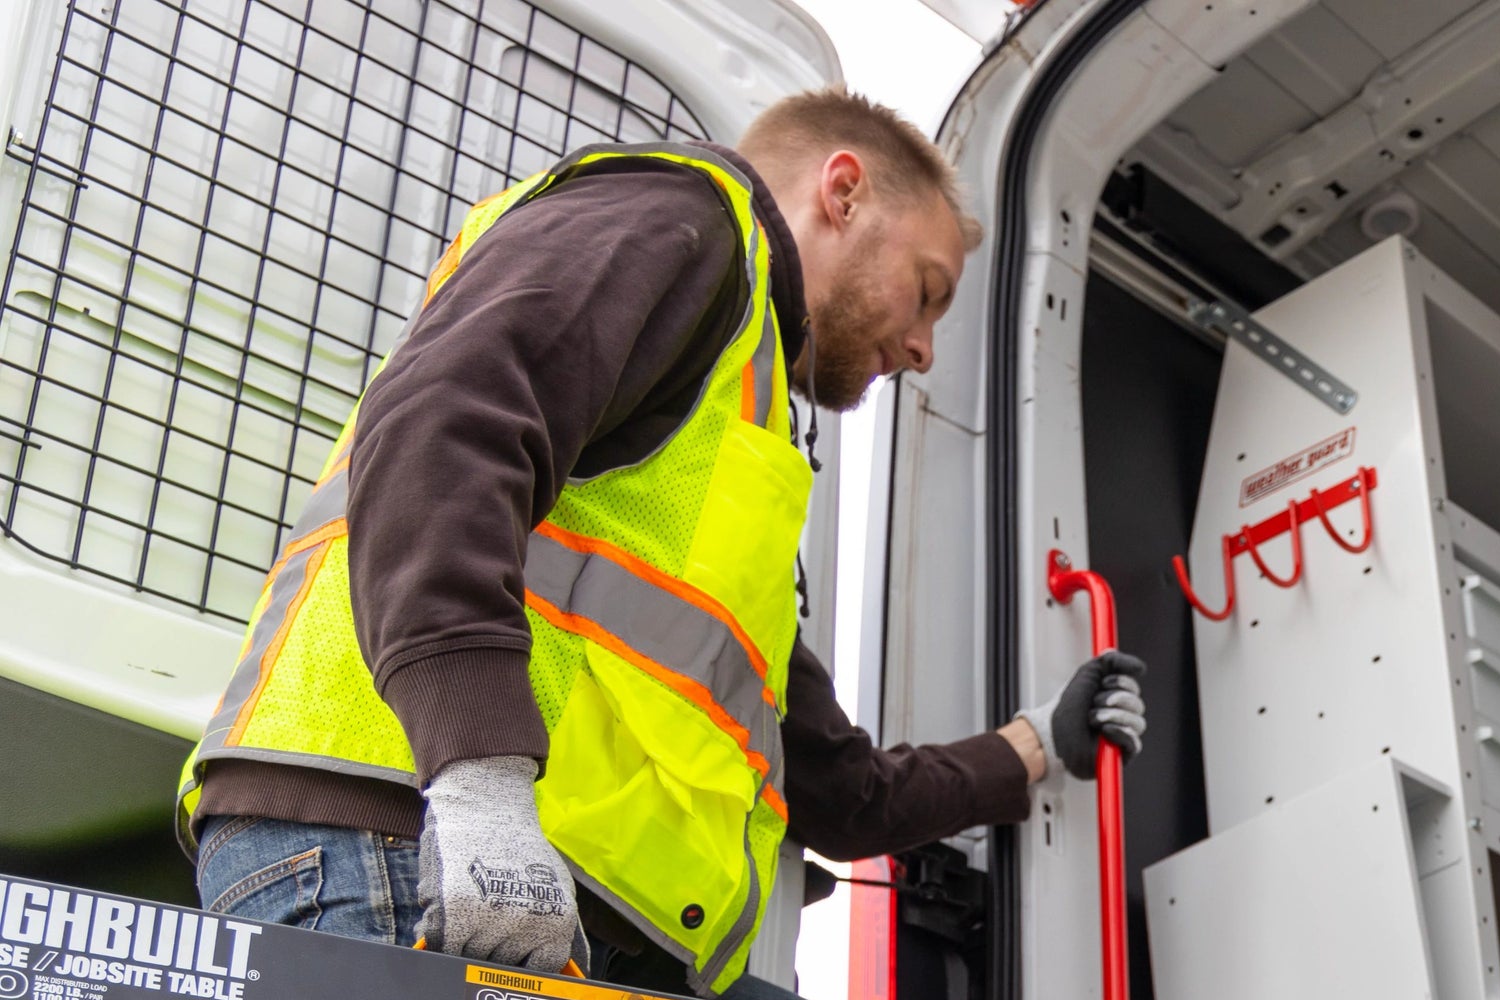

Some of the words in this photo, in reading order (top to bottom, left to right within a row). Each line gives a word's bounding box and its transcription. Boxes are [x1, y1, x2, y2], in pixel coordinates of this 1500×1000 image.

[1246, 457, 1302, 497] weather
[490, 879, 564, 903] DEFENDER
[35, 975, 49, 983] MAX
[50, 977, 90, 990] DISTRIBUTED
[90, 984, 108, 992] LOAD
[54, 954, 164, 990] JOBSITE
[478, 970, 544, 992] TOUGHBUILT
[33, 982, 64, 995] 2200
[65, 987, 84, 999] LB.
